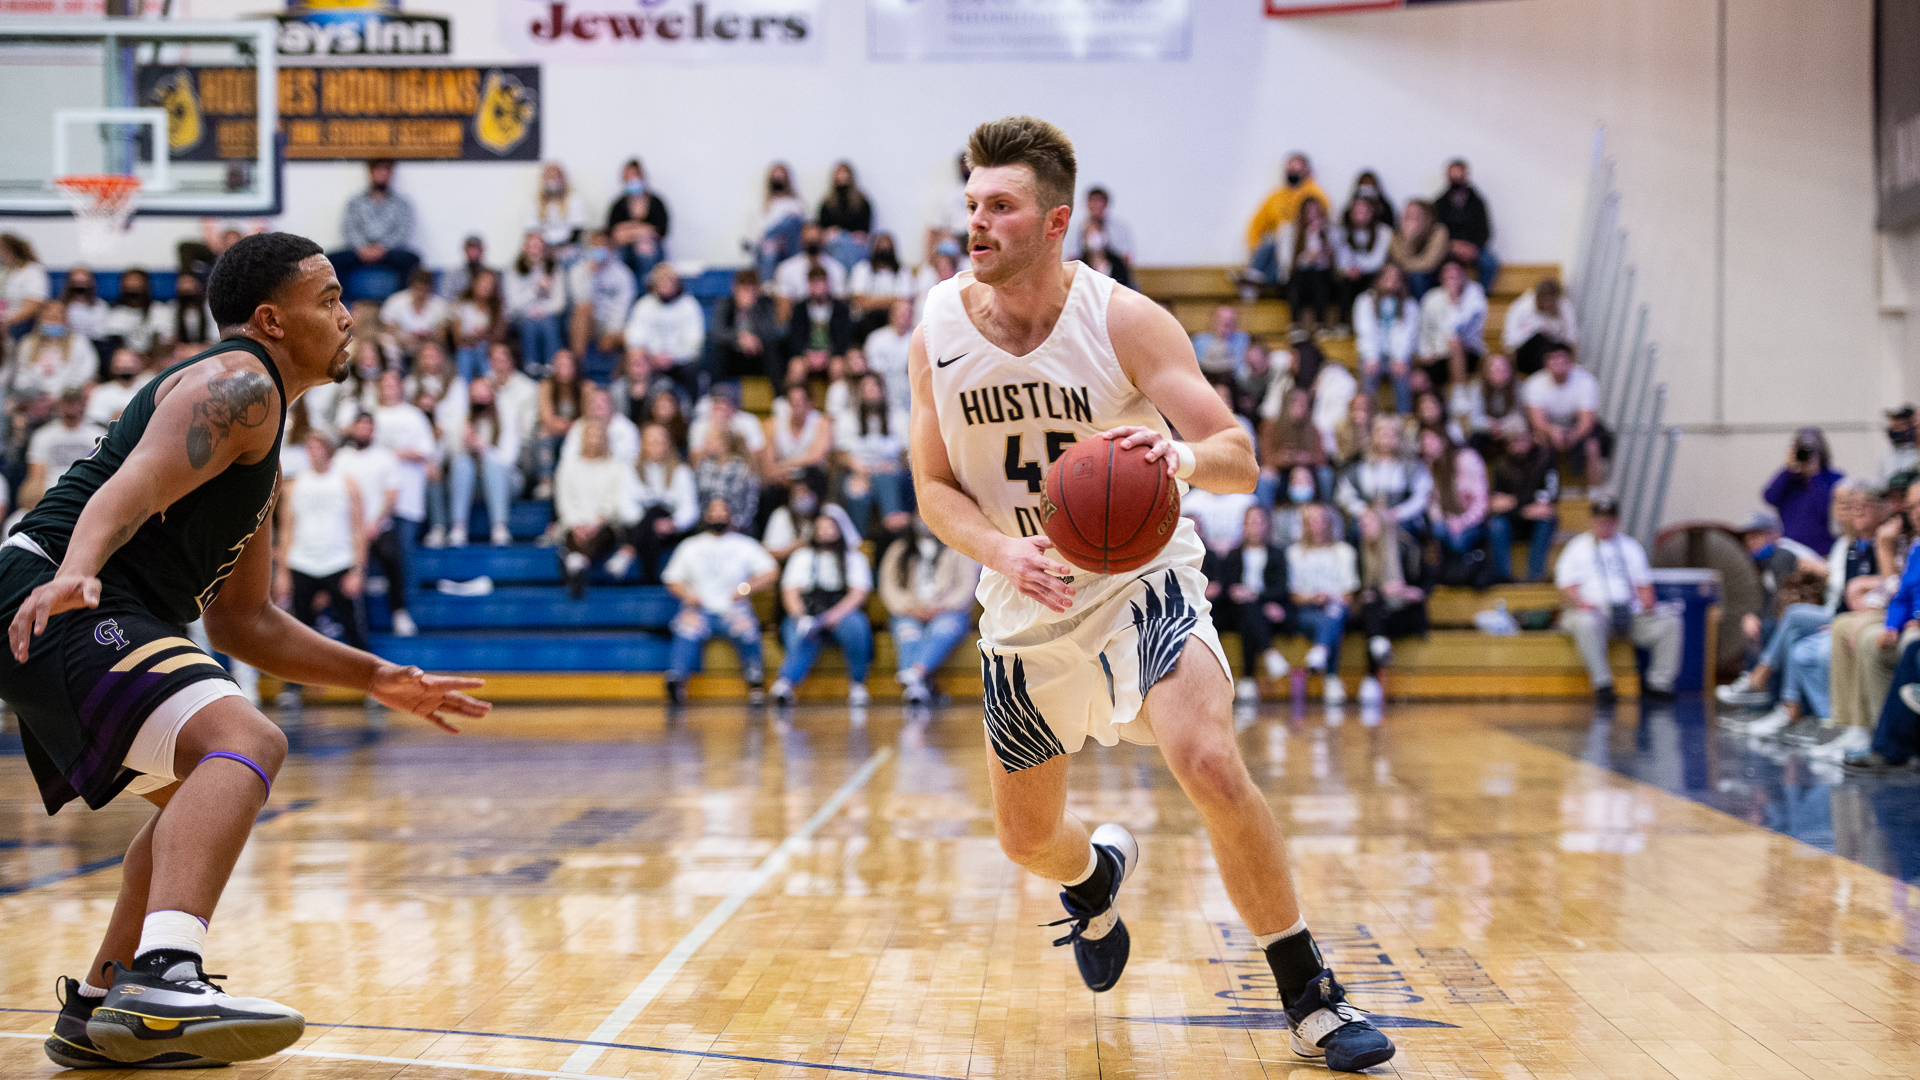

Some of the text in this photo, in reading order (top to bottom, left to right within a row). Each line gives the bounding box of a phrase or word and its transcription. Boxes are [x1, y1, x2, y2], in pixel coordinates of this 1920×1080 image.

[276, 19, 362, 58] ays
[530, 2, 807, 41] Jewelers
[959, 381, 1093, 426] HUSTLIN
